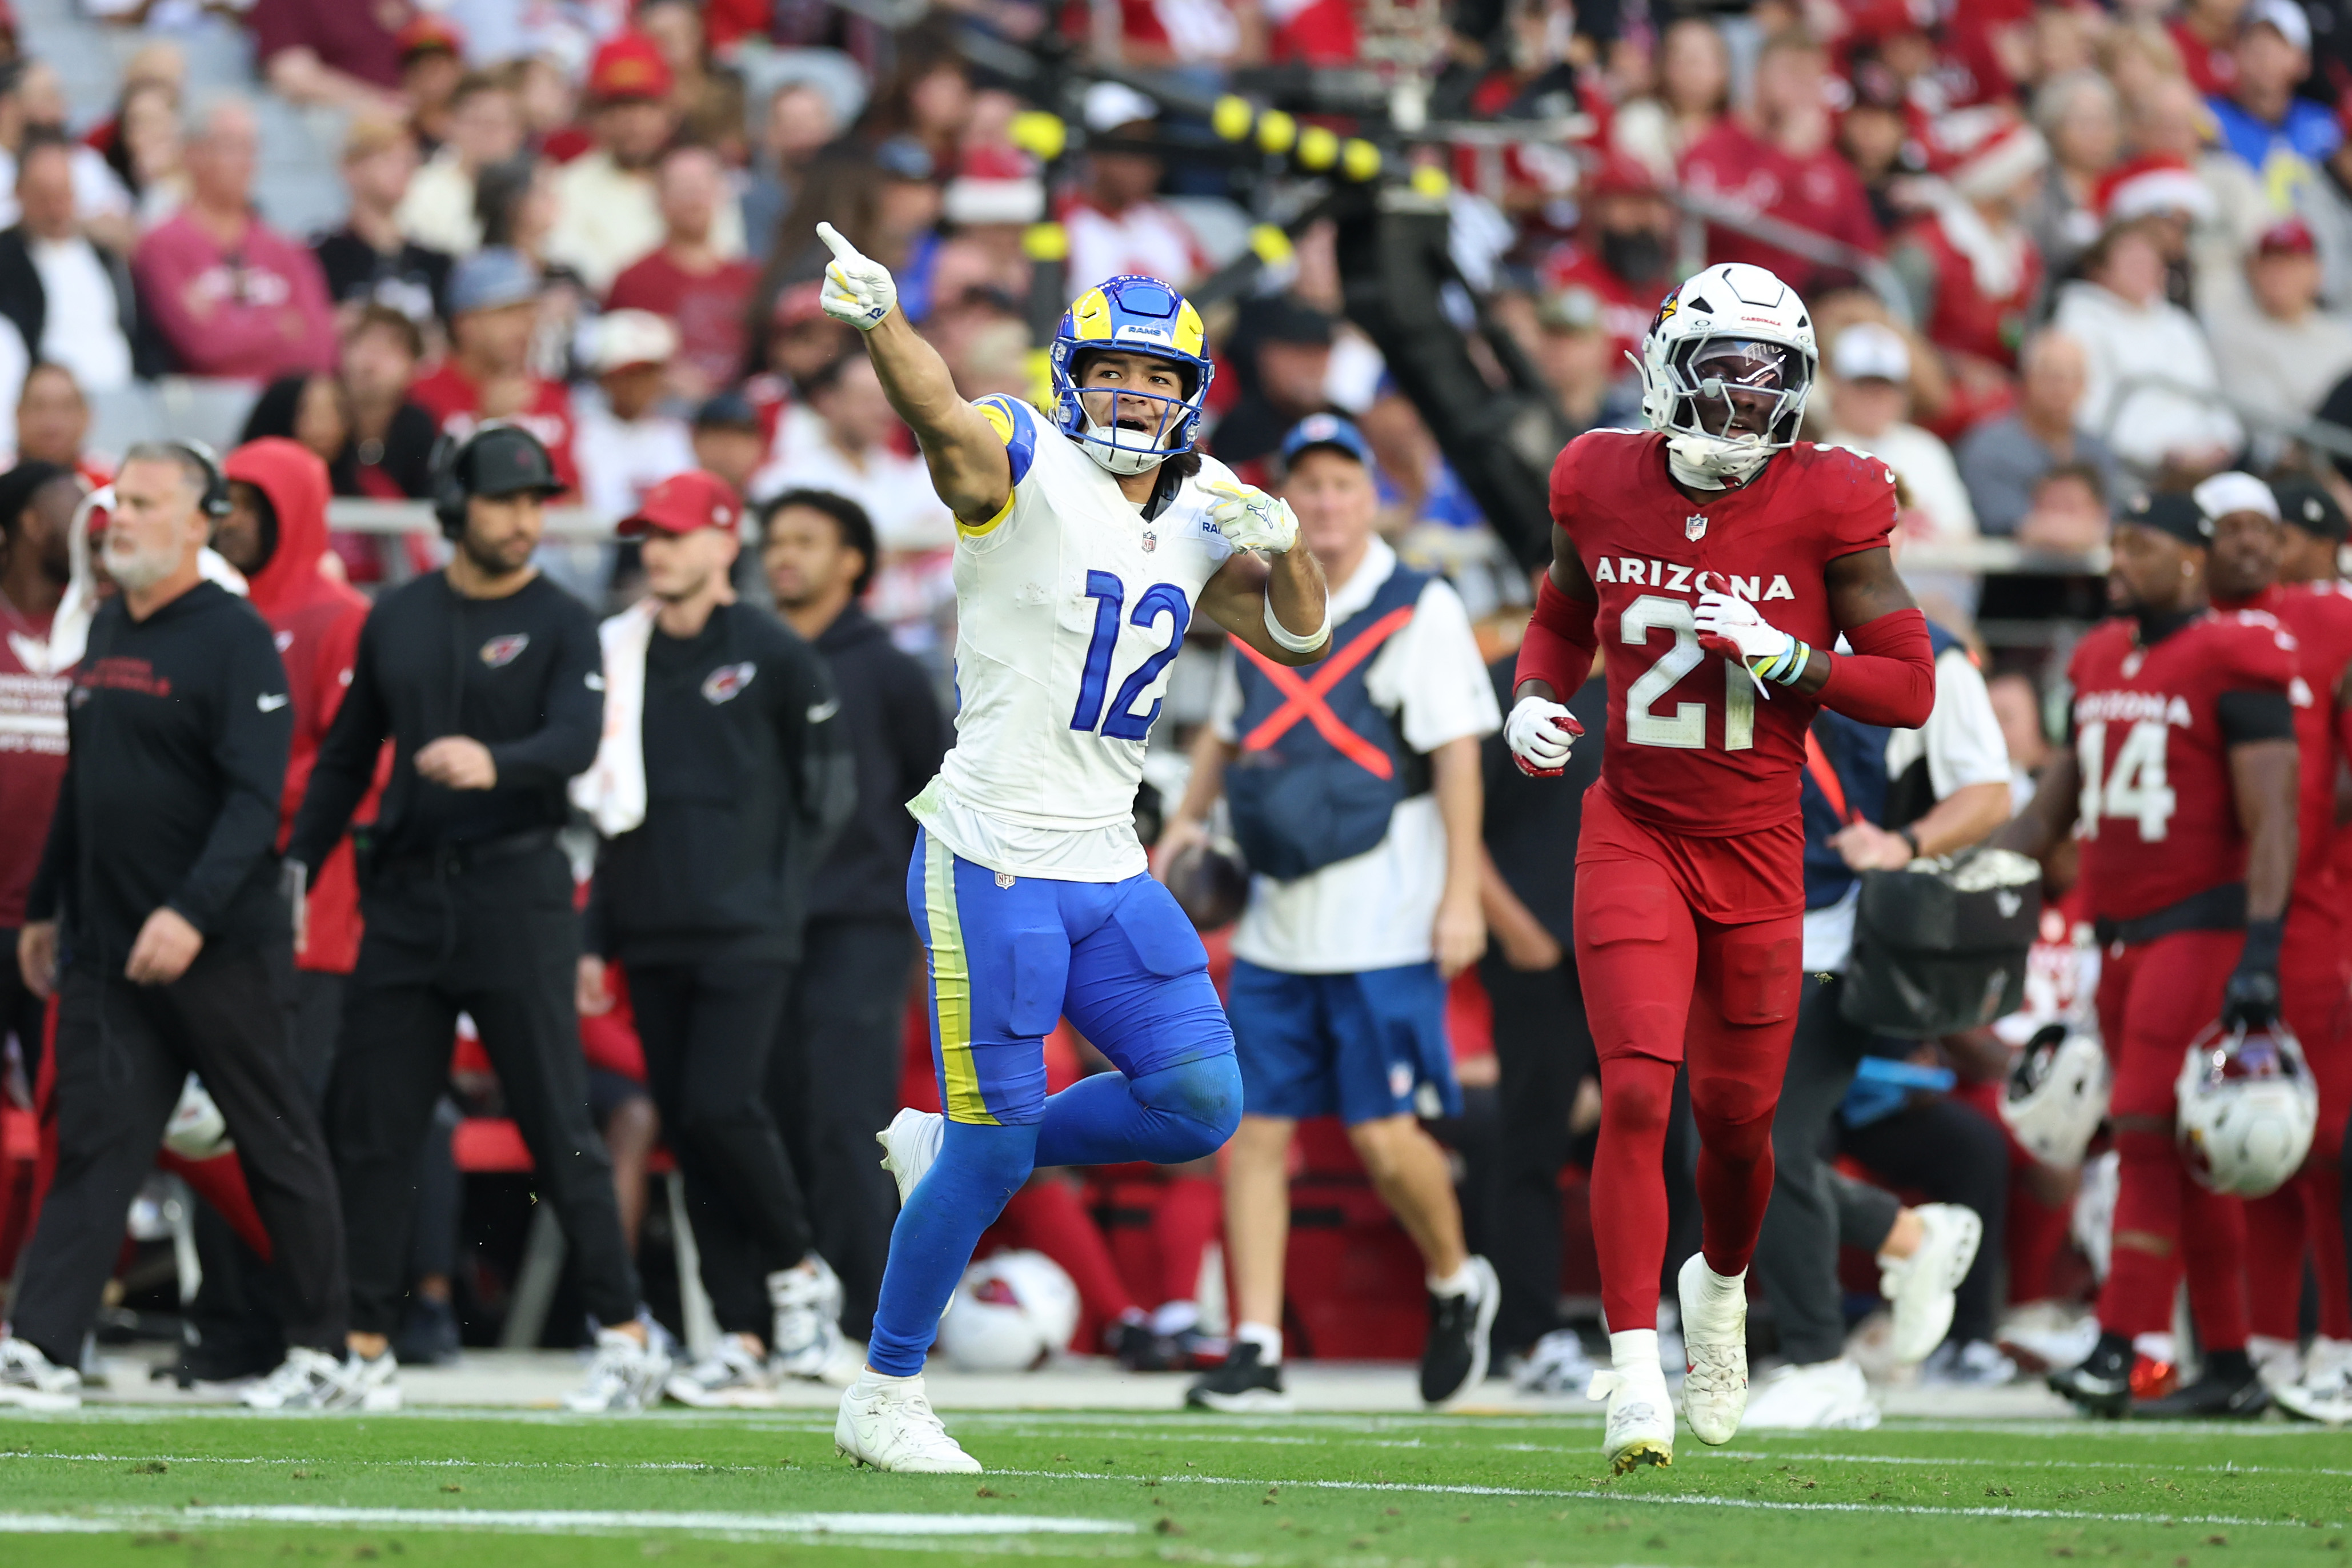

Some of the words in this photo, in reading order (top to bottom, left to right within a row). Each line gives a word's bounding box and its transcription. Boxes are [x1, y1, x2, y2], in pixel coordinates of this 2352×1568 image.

[865, 307, 886, 320] 12
[1741, 316, 1781, 326] CARDINALS
[1128, 326, 1161, 336] RAMS
[1144, 539, 1155, 550] NFL
[1596, 557, 1796, 602] ARIZONA
[1069, 568, 1191, 741] 12
[1621, 594, 1755, 751] 21
[2075, 720, 2177, 843] 14
[998, 874, 1013, 884] NFL
